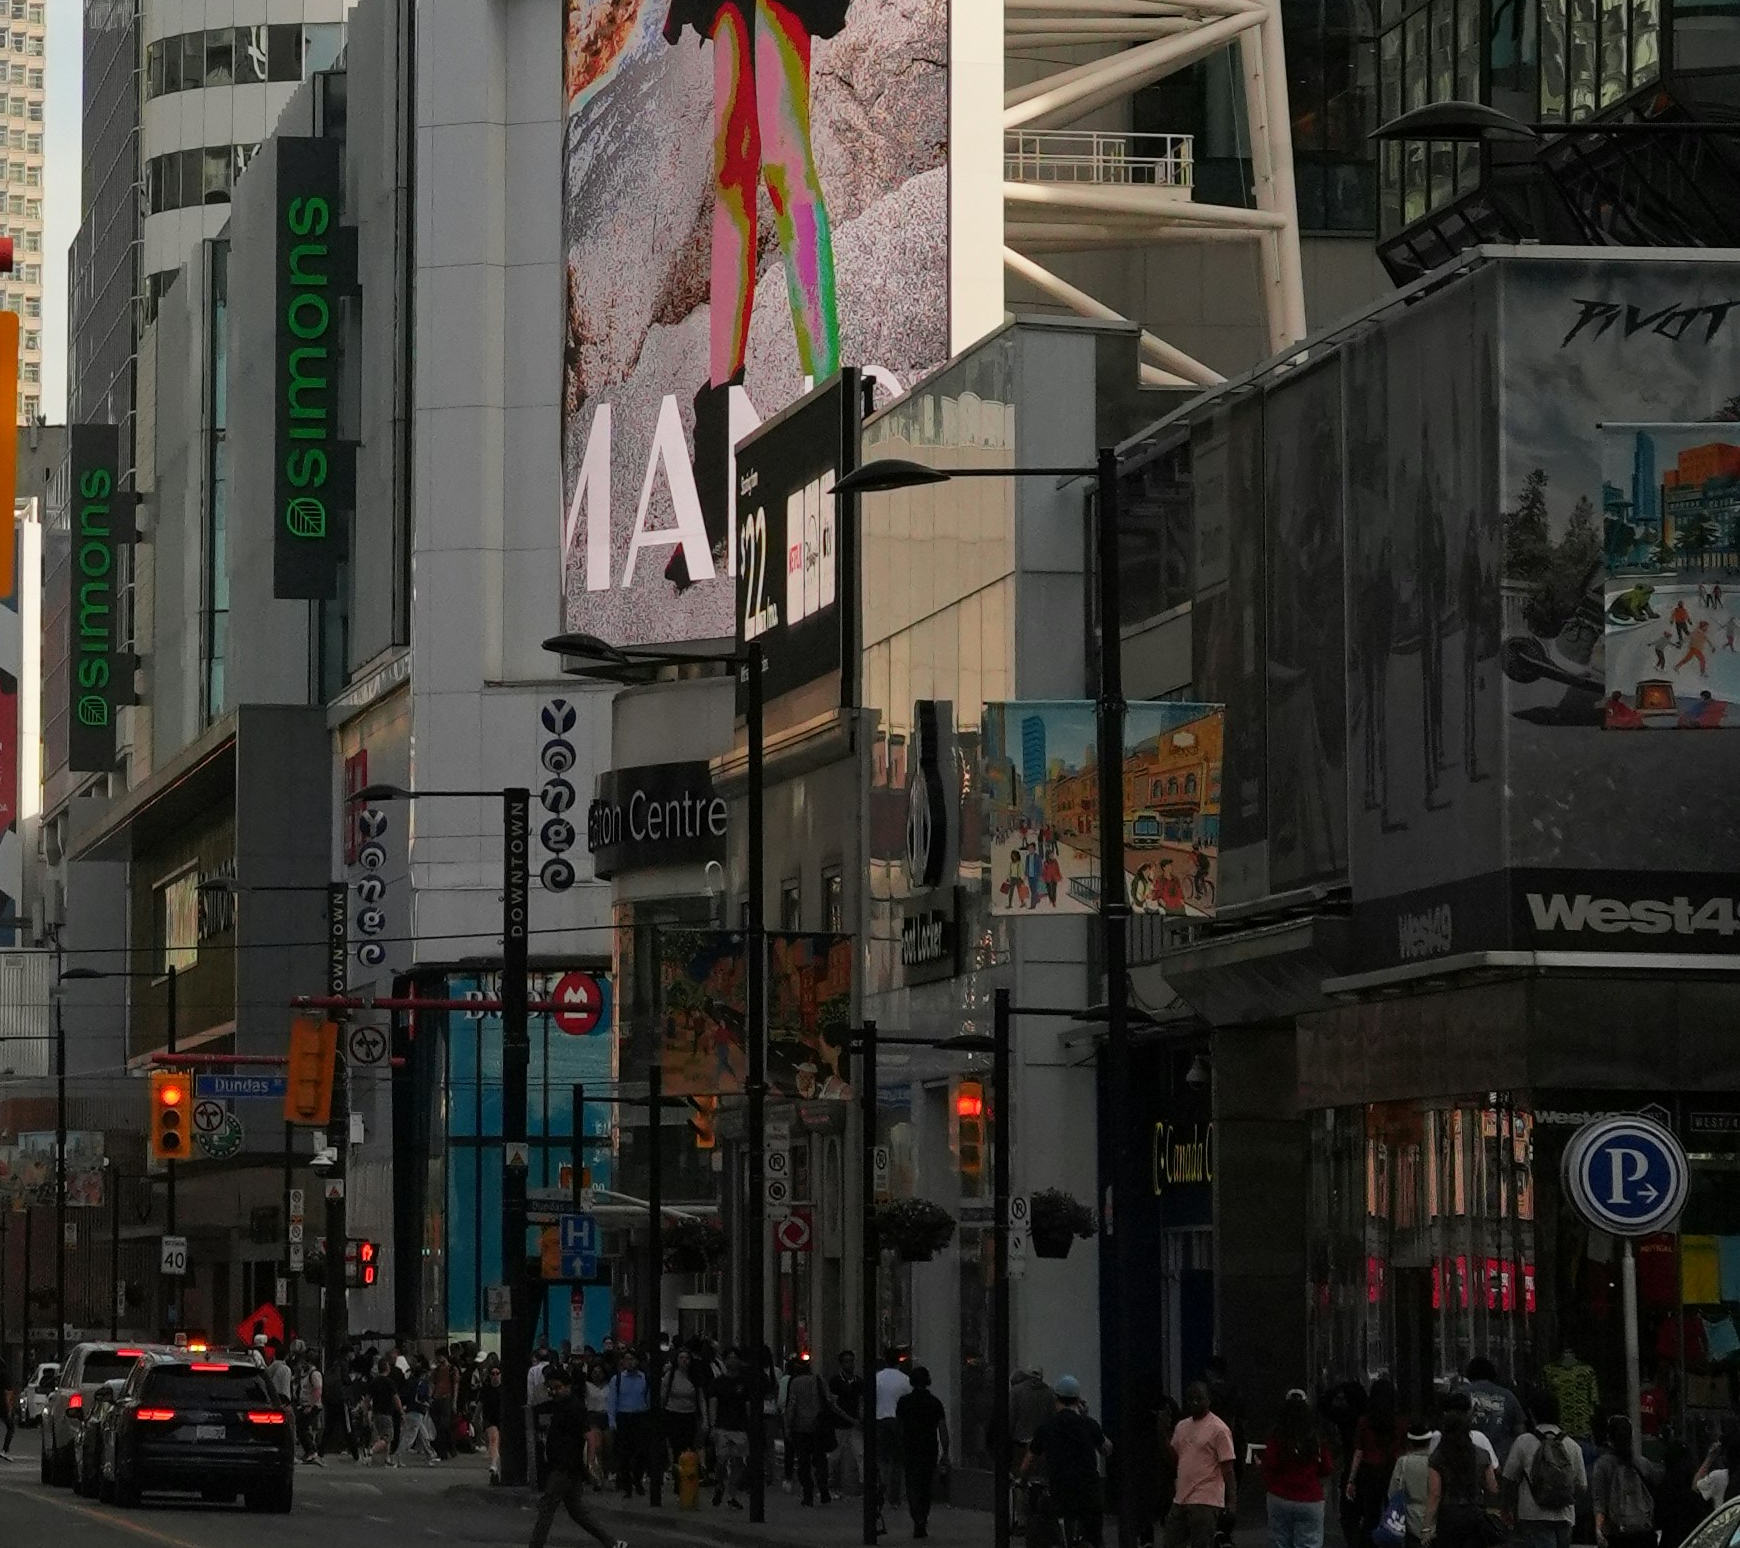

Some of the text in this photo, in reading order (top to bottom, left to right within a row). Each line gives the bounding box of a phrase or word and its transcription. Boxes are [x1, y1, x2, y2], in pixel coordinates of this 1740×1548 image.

[286, 195, 330, 489] simons
[79, 467, 112, 689] simons
[540, 698, 576, 893] Yonge
[629, 789, 728, 842] Centre
[357, 809, 388, 968] Yonge
[510, 802, 525, 938] DOWNTOWN
[1526, 892, 1740, 937] West4
[214, 1078, 269, 1094] Dundas
[1165, 1123, 1203, 1185] Canada
[1605, 1148, 1649, 1205] P
[164, 1252, 185, 1270] 40
[567, 1219, 590, 1248] H
